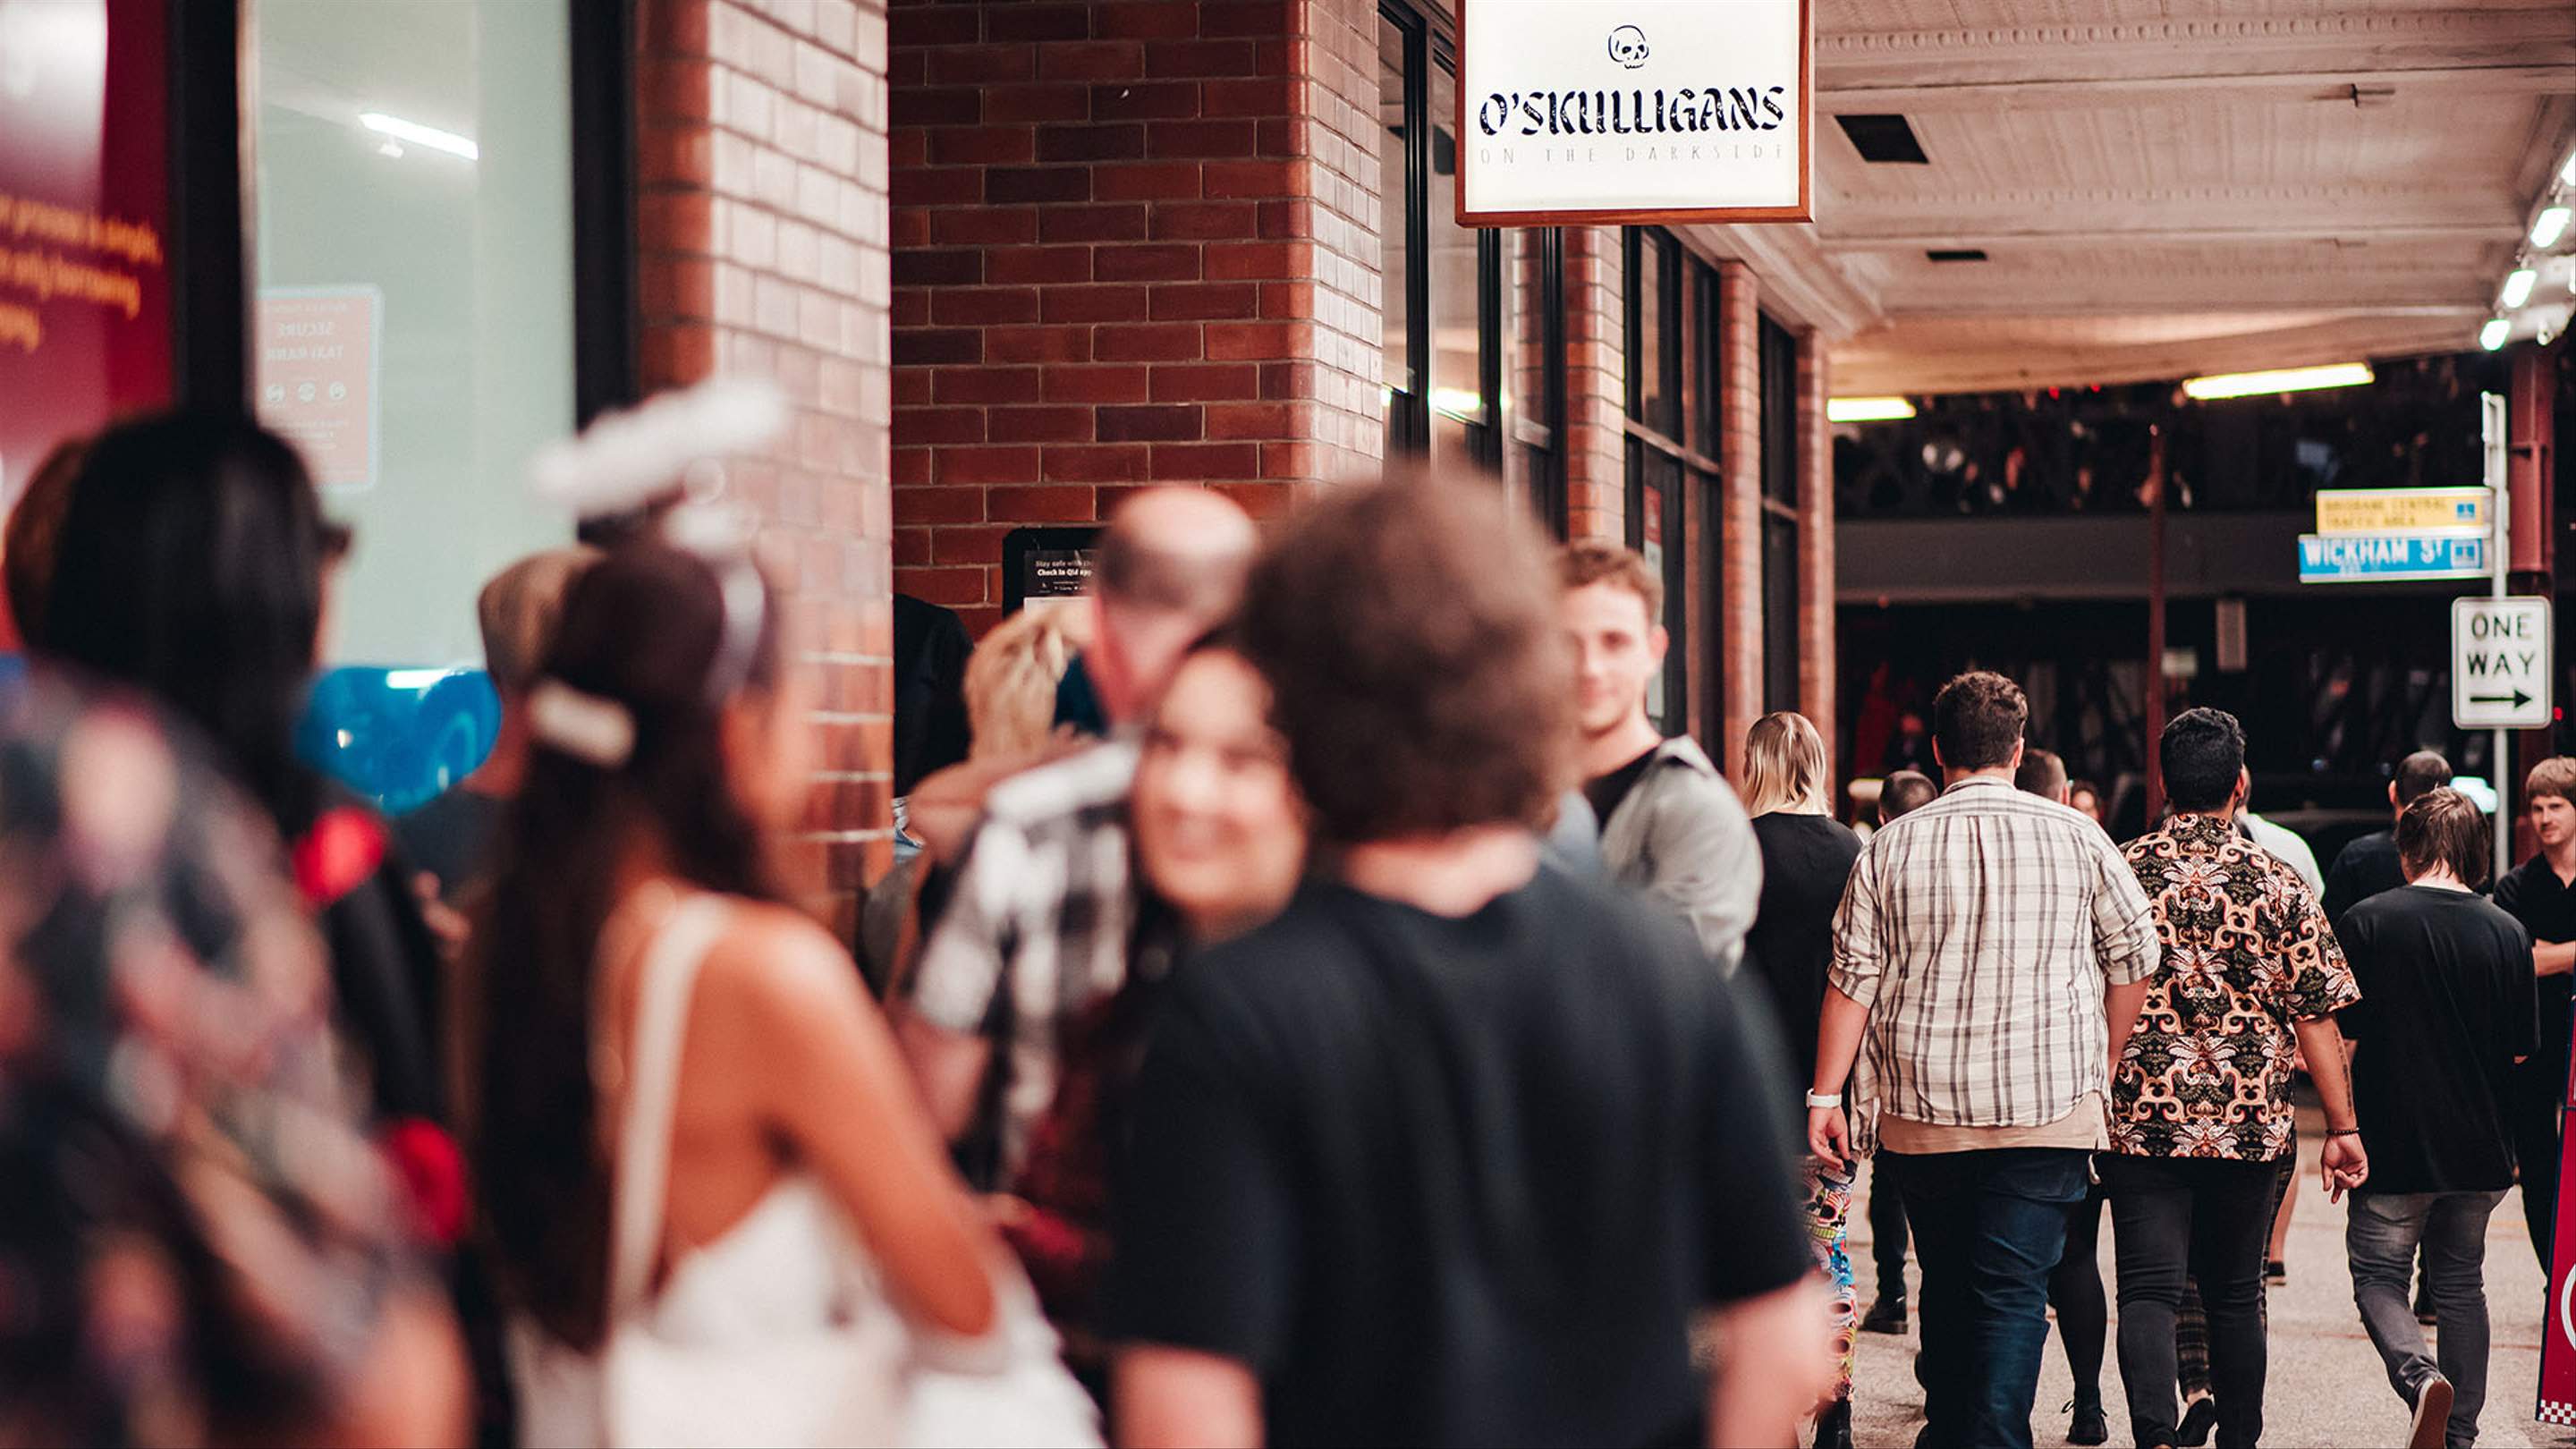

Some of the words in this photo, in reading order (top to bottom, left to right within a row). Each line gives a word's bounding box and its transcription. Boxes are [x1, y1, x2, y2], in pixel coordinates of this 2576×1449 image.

[1479, 86, 1785, 136] O'SKULLIGANS
[1480, 147, 1515, 165] ON
[1546, 146, 1597, 164] THE
[1625, 142, 1784, 162] DARKSIDE
[2303, 538, 2409, 566] WICKHAM
[2470, 612, 2533, 641] ONE
[2467, 653, 2535, 675] WAY
